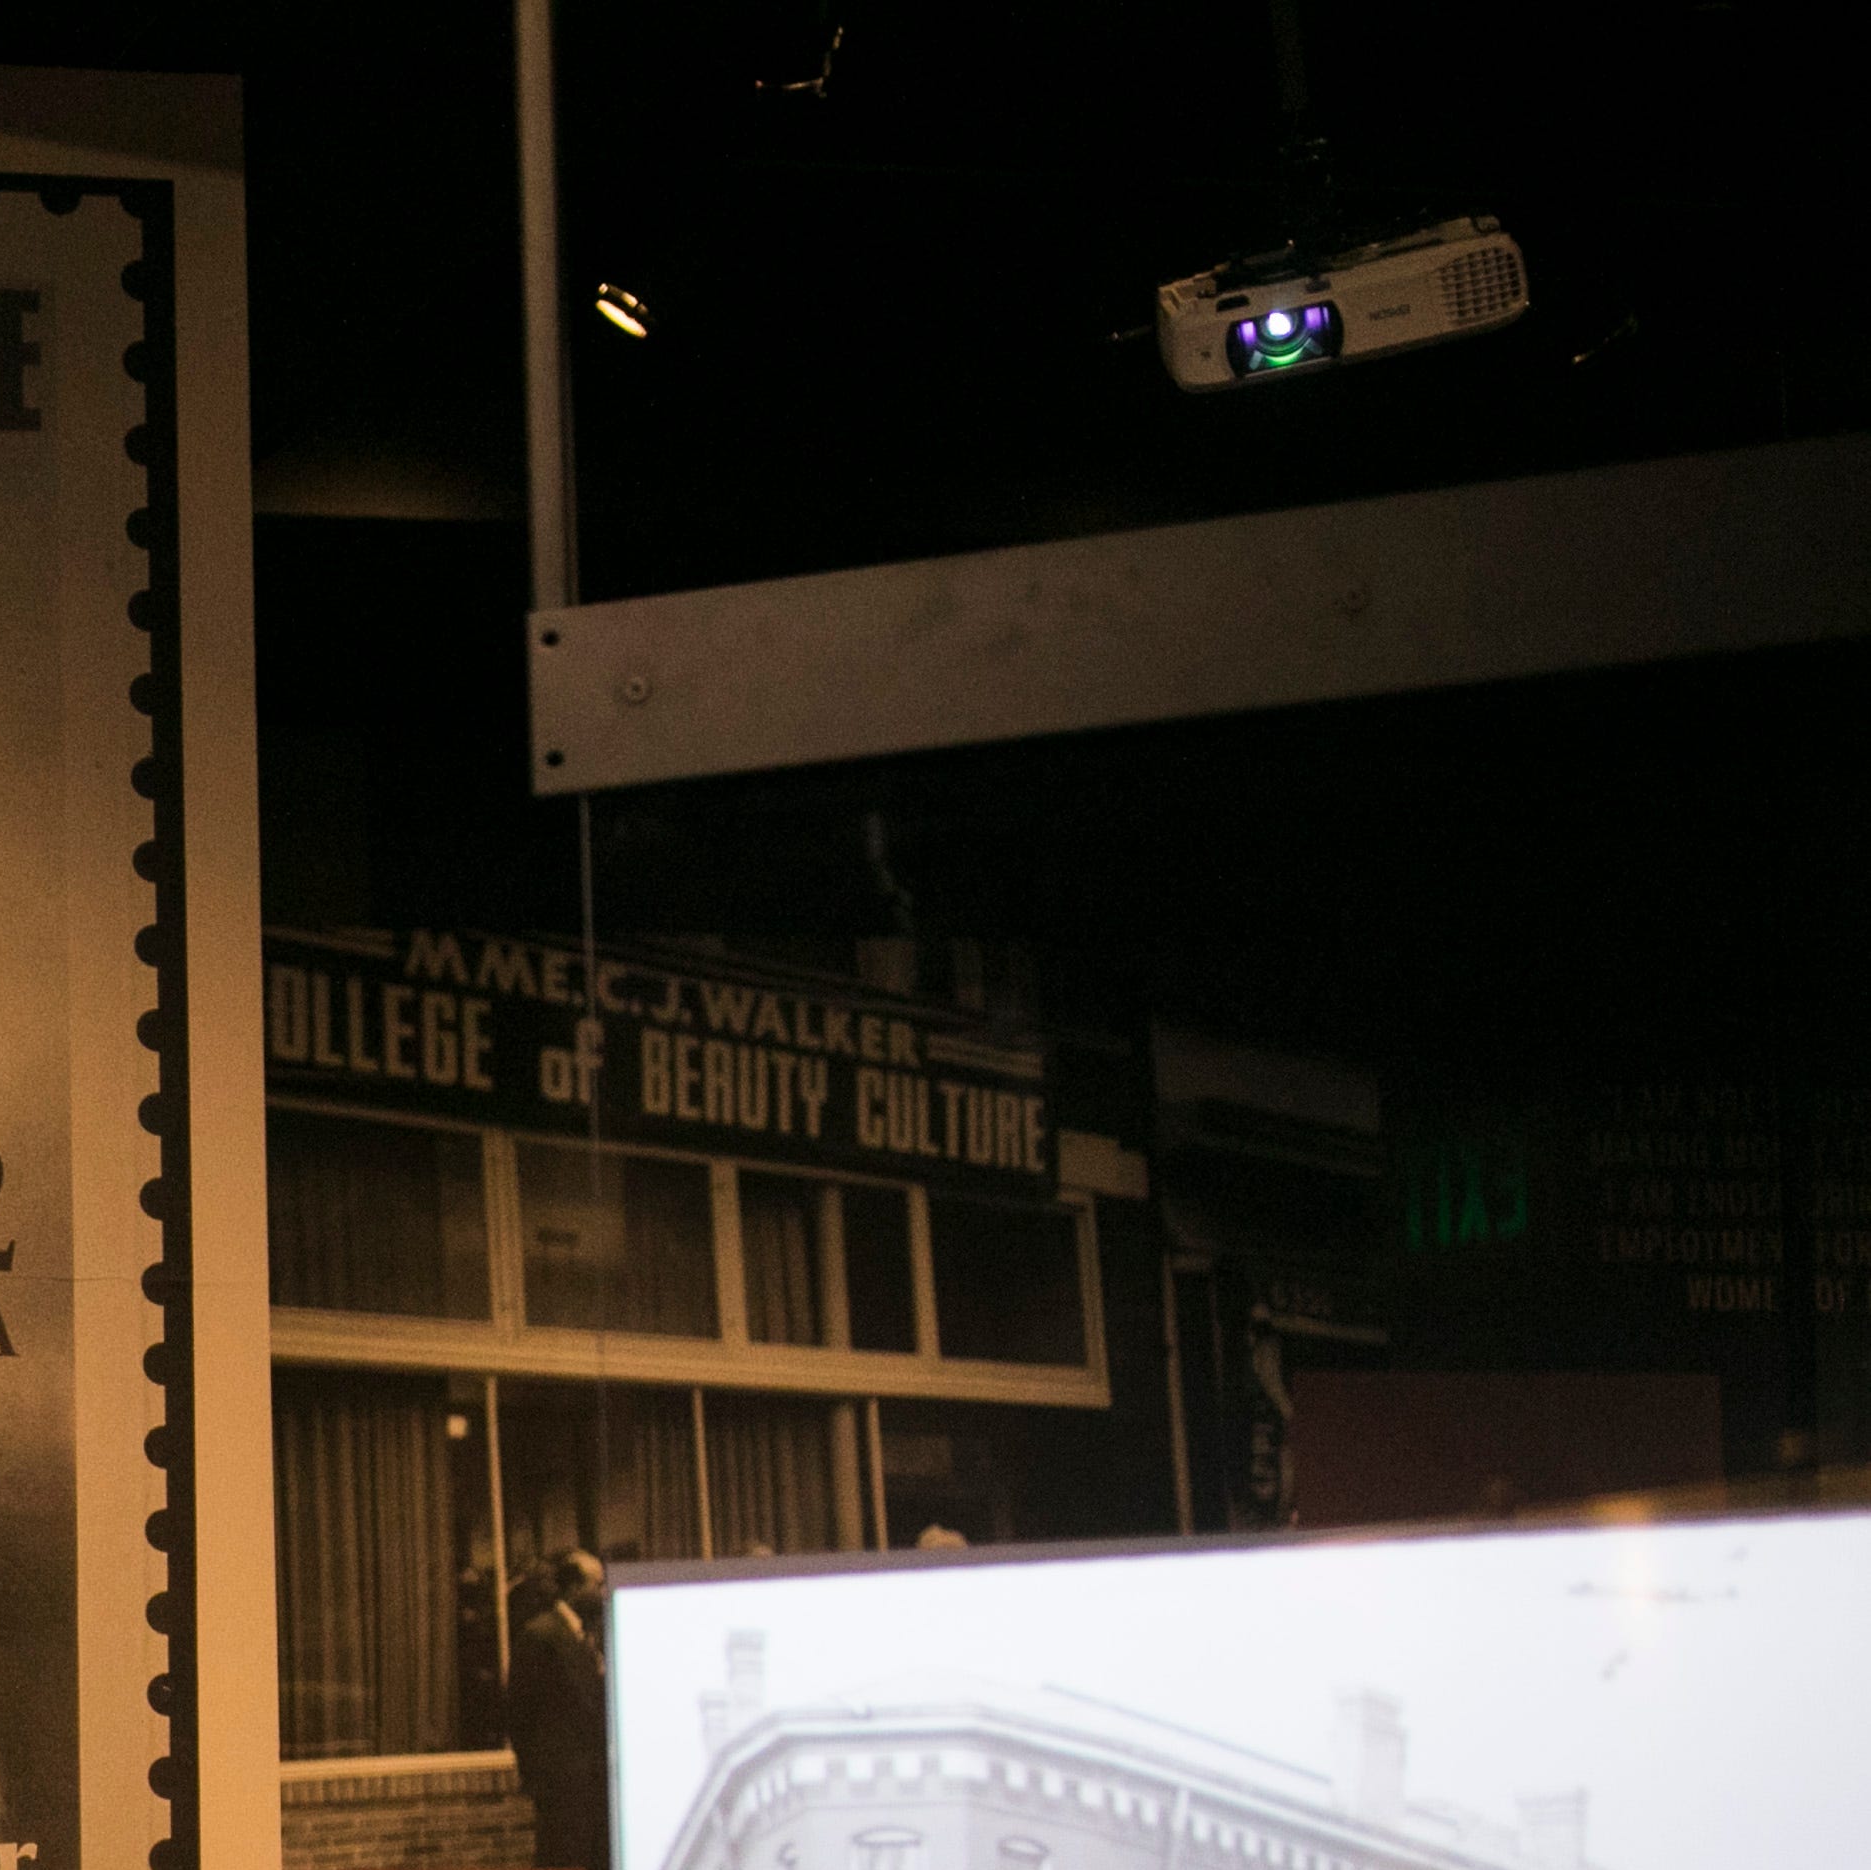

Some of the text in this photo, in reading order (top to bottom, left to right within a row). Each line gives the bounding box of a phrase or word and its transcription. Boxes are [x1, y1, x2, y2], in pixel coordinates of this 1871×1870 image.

[699, 979, 921, 1068] WALKER
[539, 1014, 606, 1105] of
[640, 1024, 829, 1139] BEAUTY
[856, 1064, 1047, 1174] CULTURE
